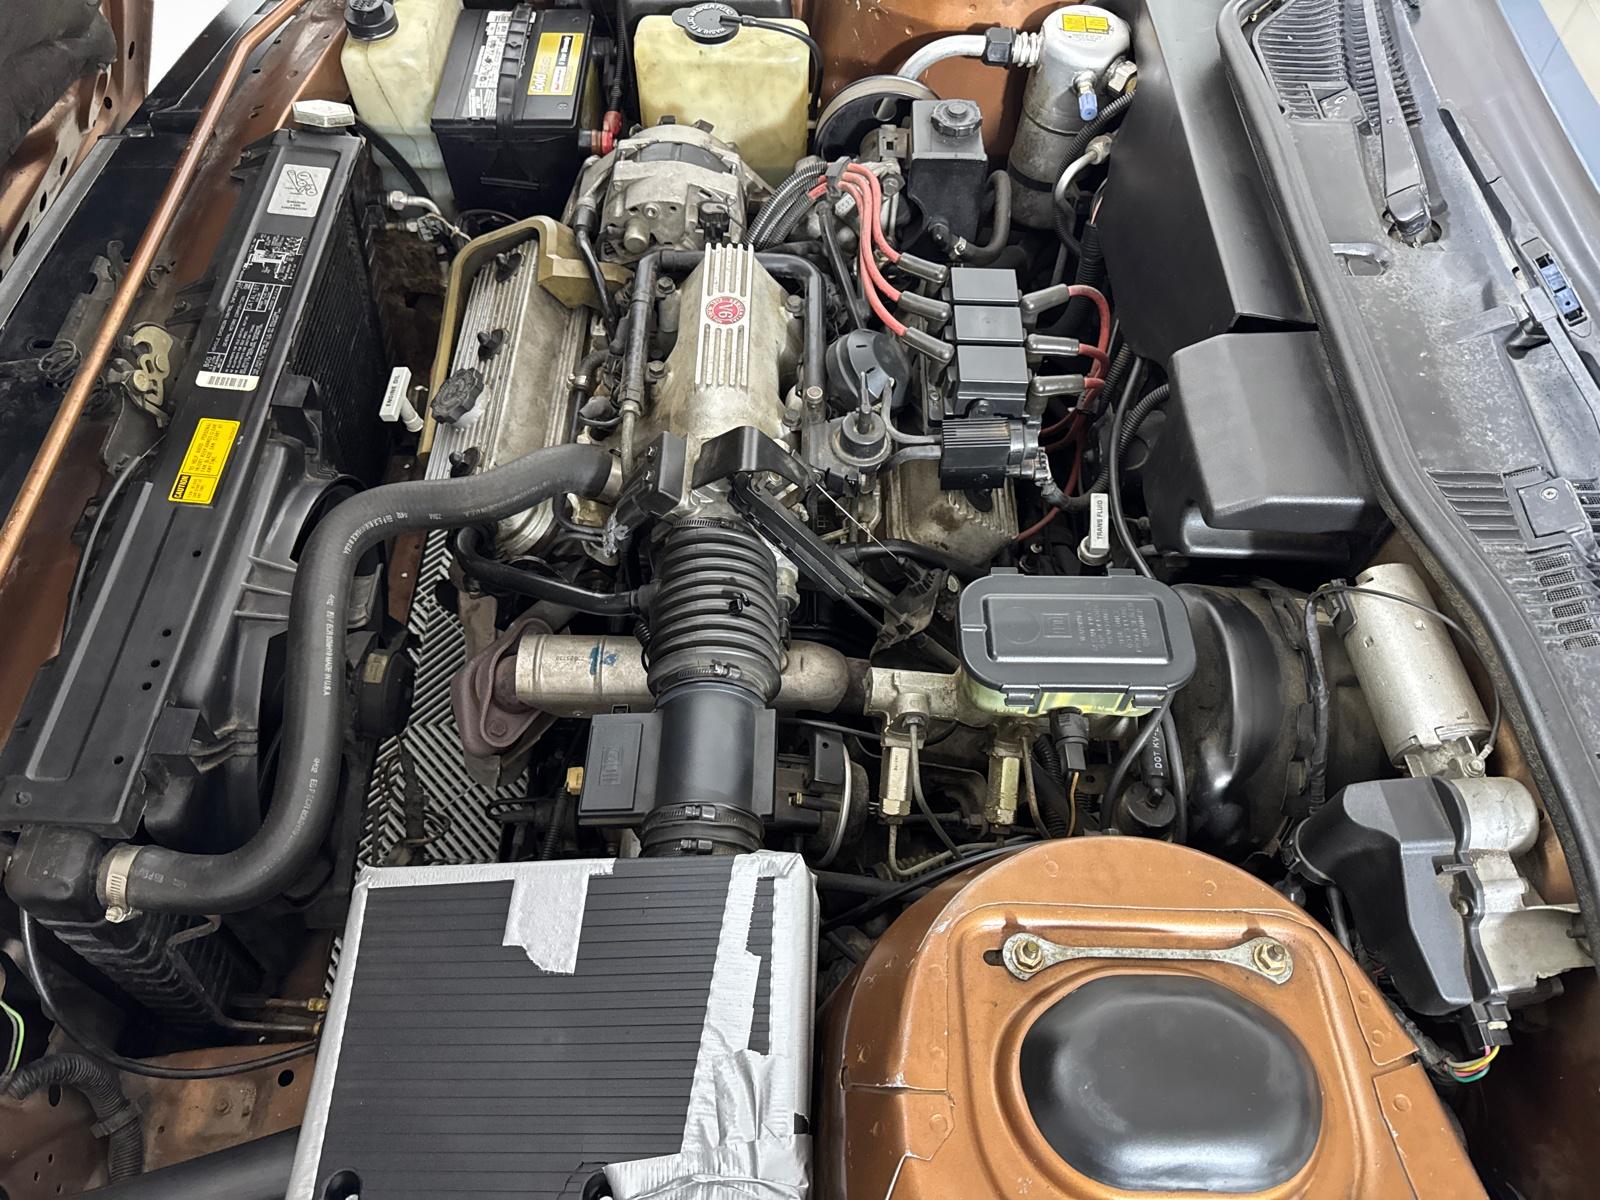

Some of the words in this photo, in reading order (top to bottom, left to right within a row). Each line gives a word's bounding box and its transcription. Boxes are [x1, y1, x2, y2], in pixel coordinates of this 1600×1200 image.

[716, 4, 733, 15] FLUID
[246, 283, 260, 310] CATALYST
[719, 304, 734, 319] V6
[174, 475, 189, 498] CAUTION
[1154, 752, 1163, 769] DOT
